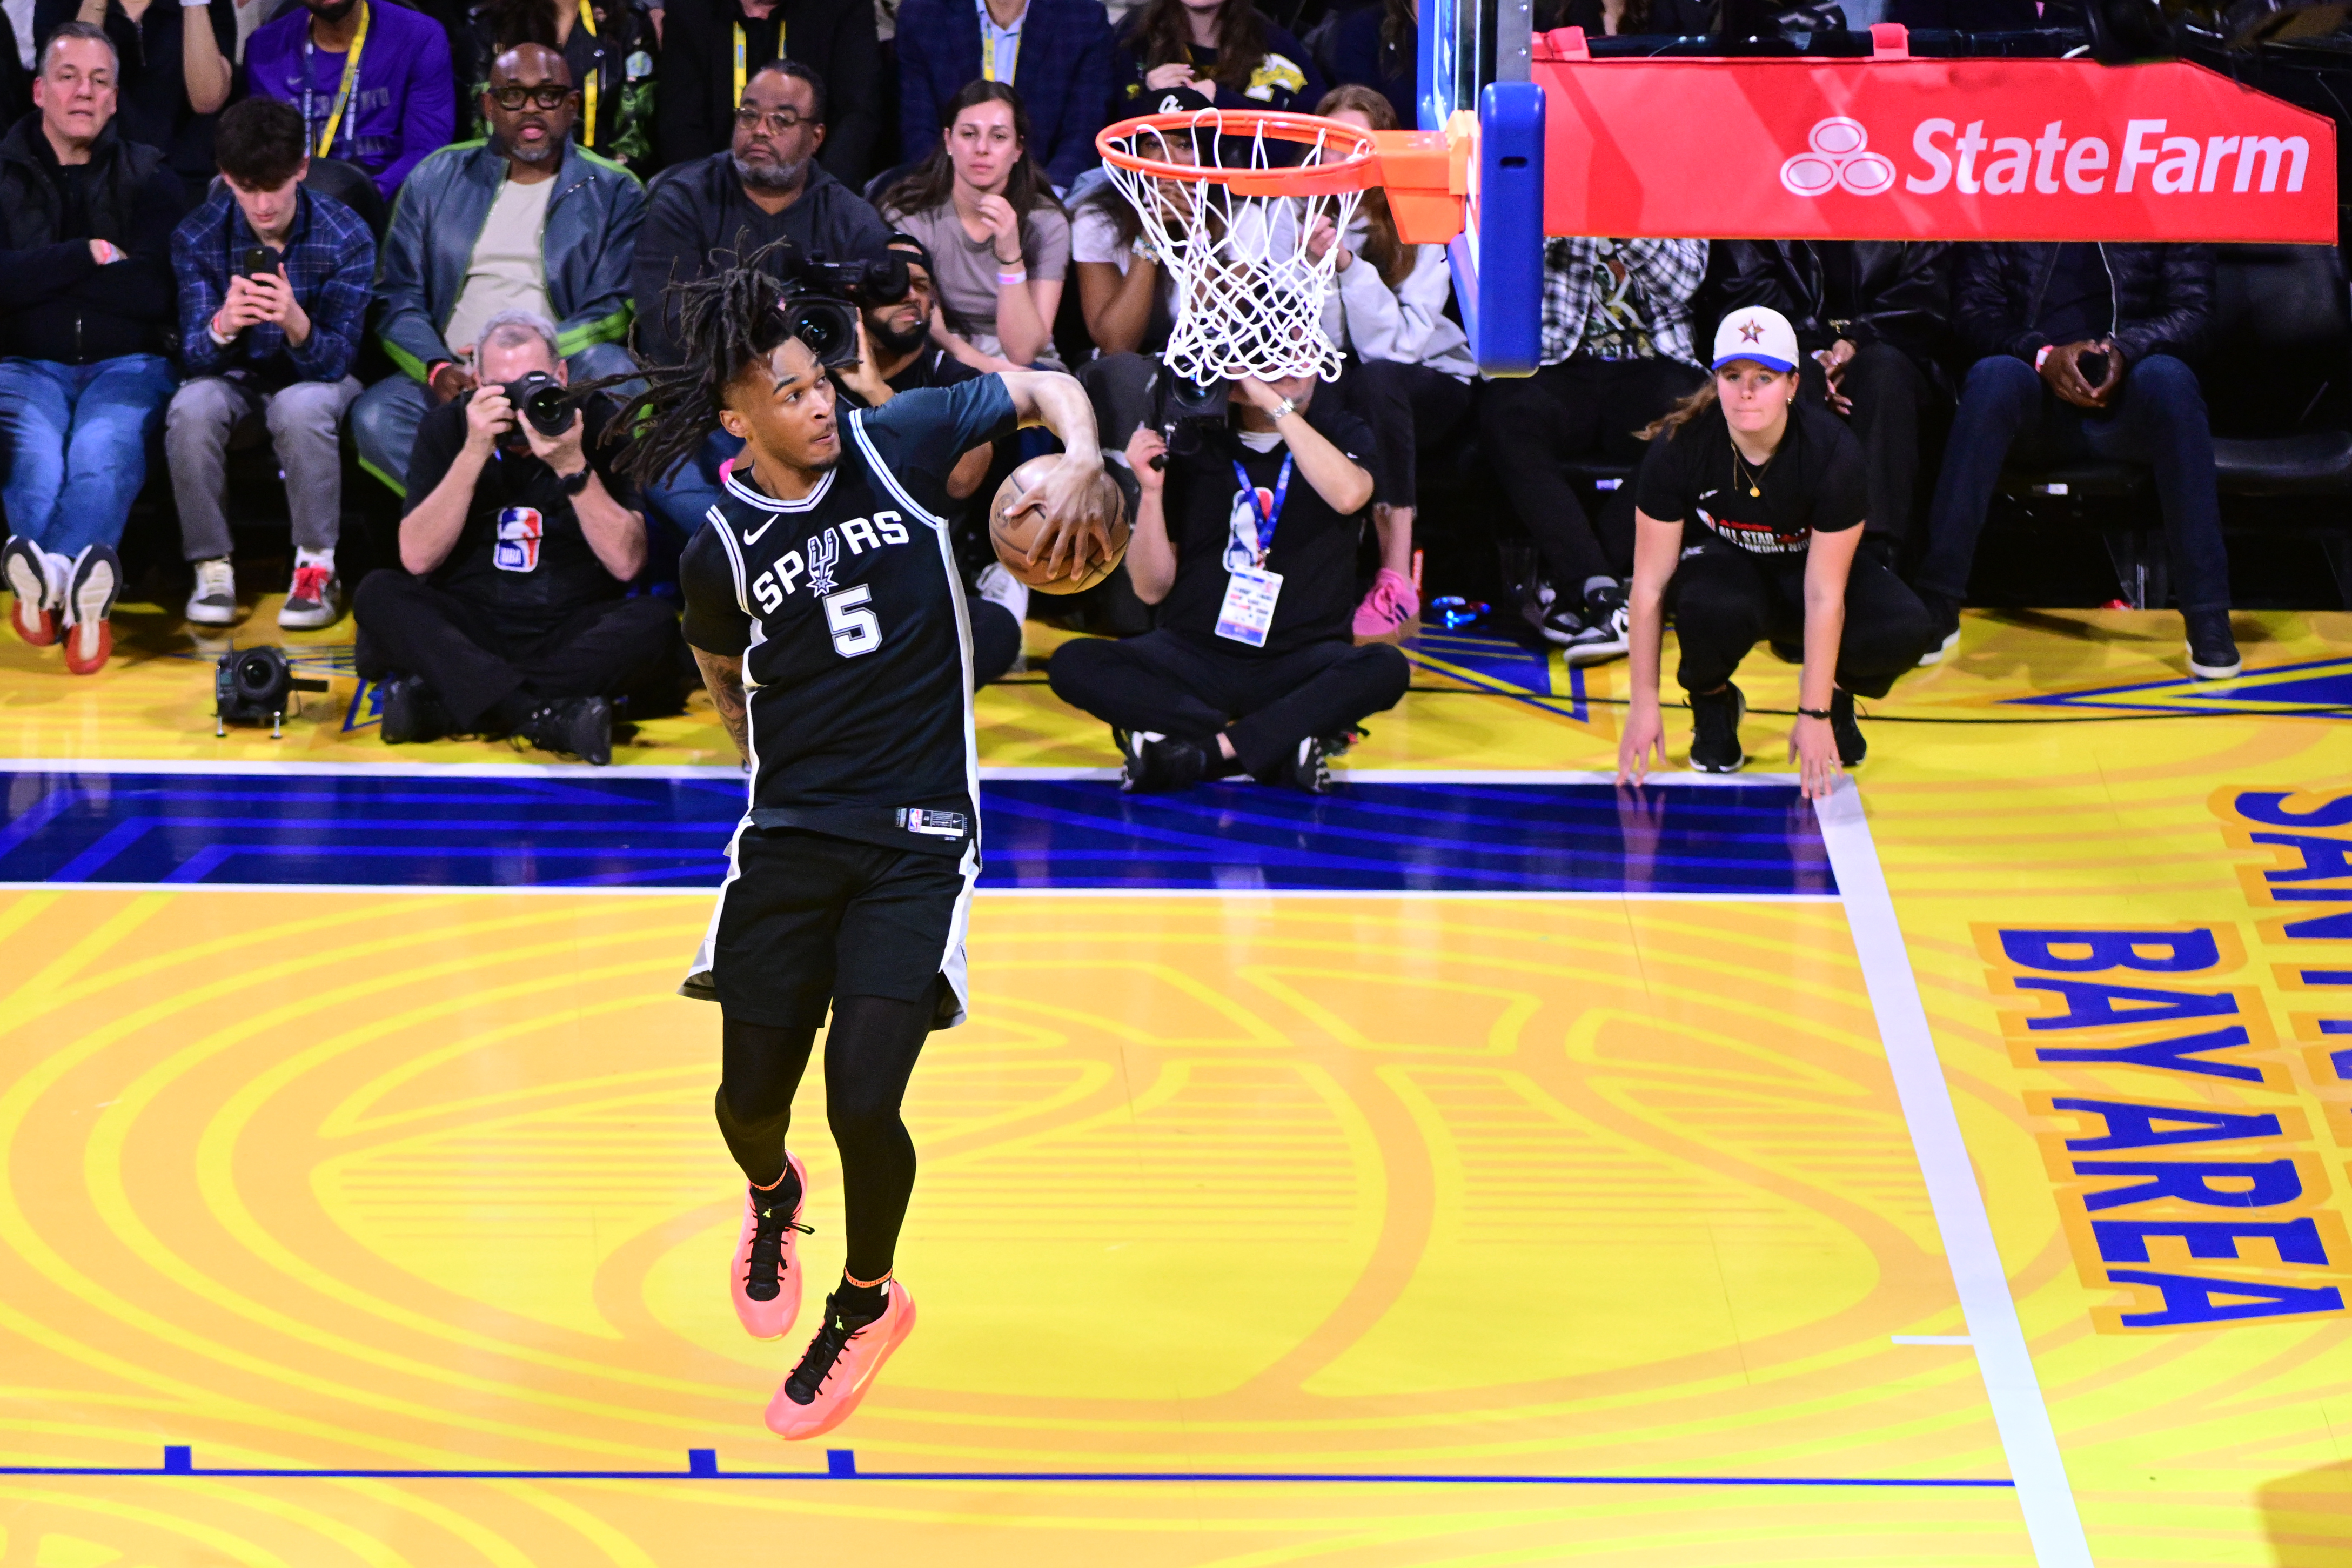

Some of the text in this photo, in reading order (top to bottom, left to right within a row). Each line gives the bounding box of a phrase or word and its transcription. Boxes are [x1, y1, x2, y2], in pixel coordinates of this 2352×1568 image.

[1905, 117, 2310, 195] State Farm
[501, 547, 521, 565] NBA
[752, 511, 910, 615] SPURS
[1741, 530, 1776, 547] STAR
[822, 583, 883, 658] 5
[1998, 927, 2264, 1083] BAY
[2051, 1097, 2346, 1328] AREA
